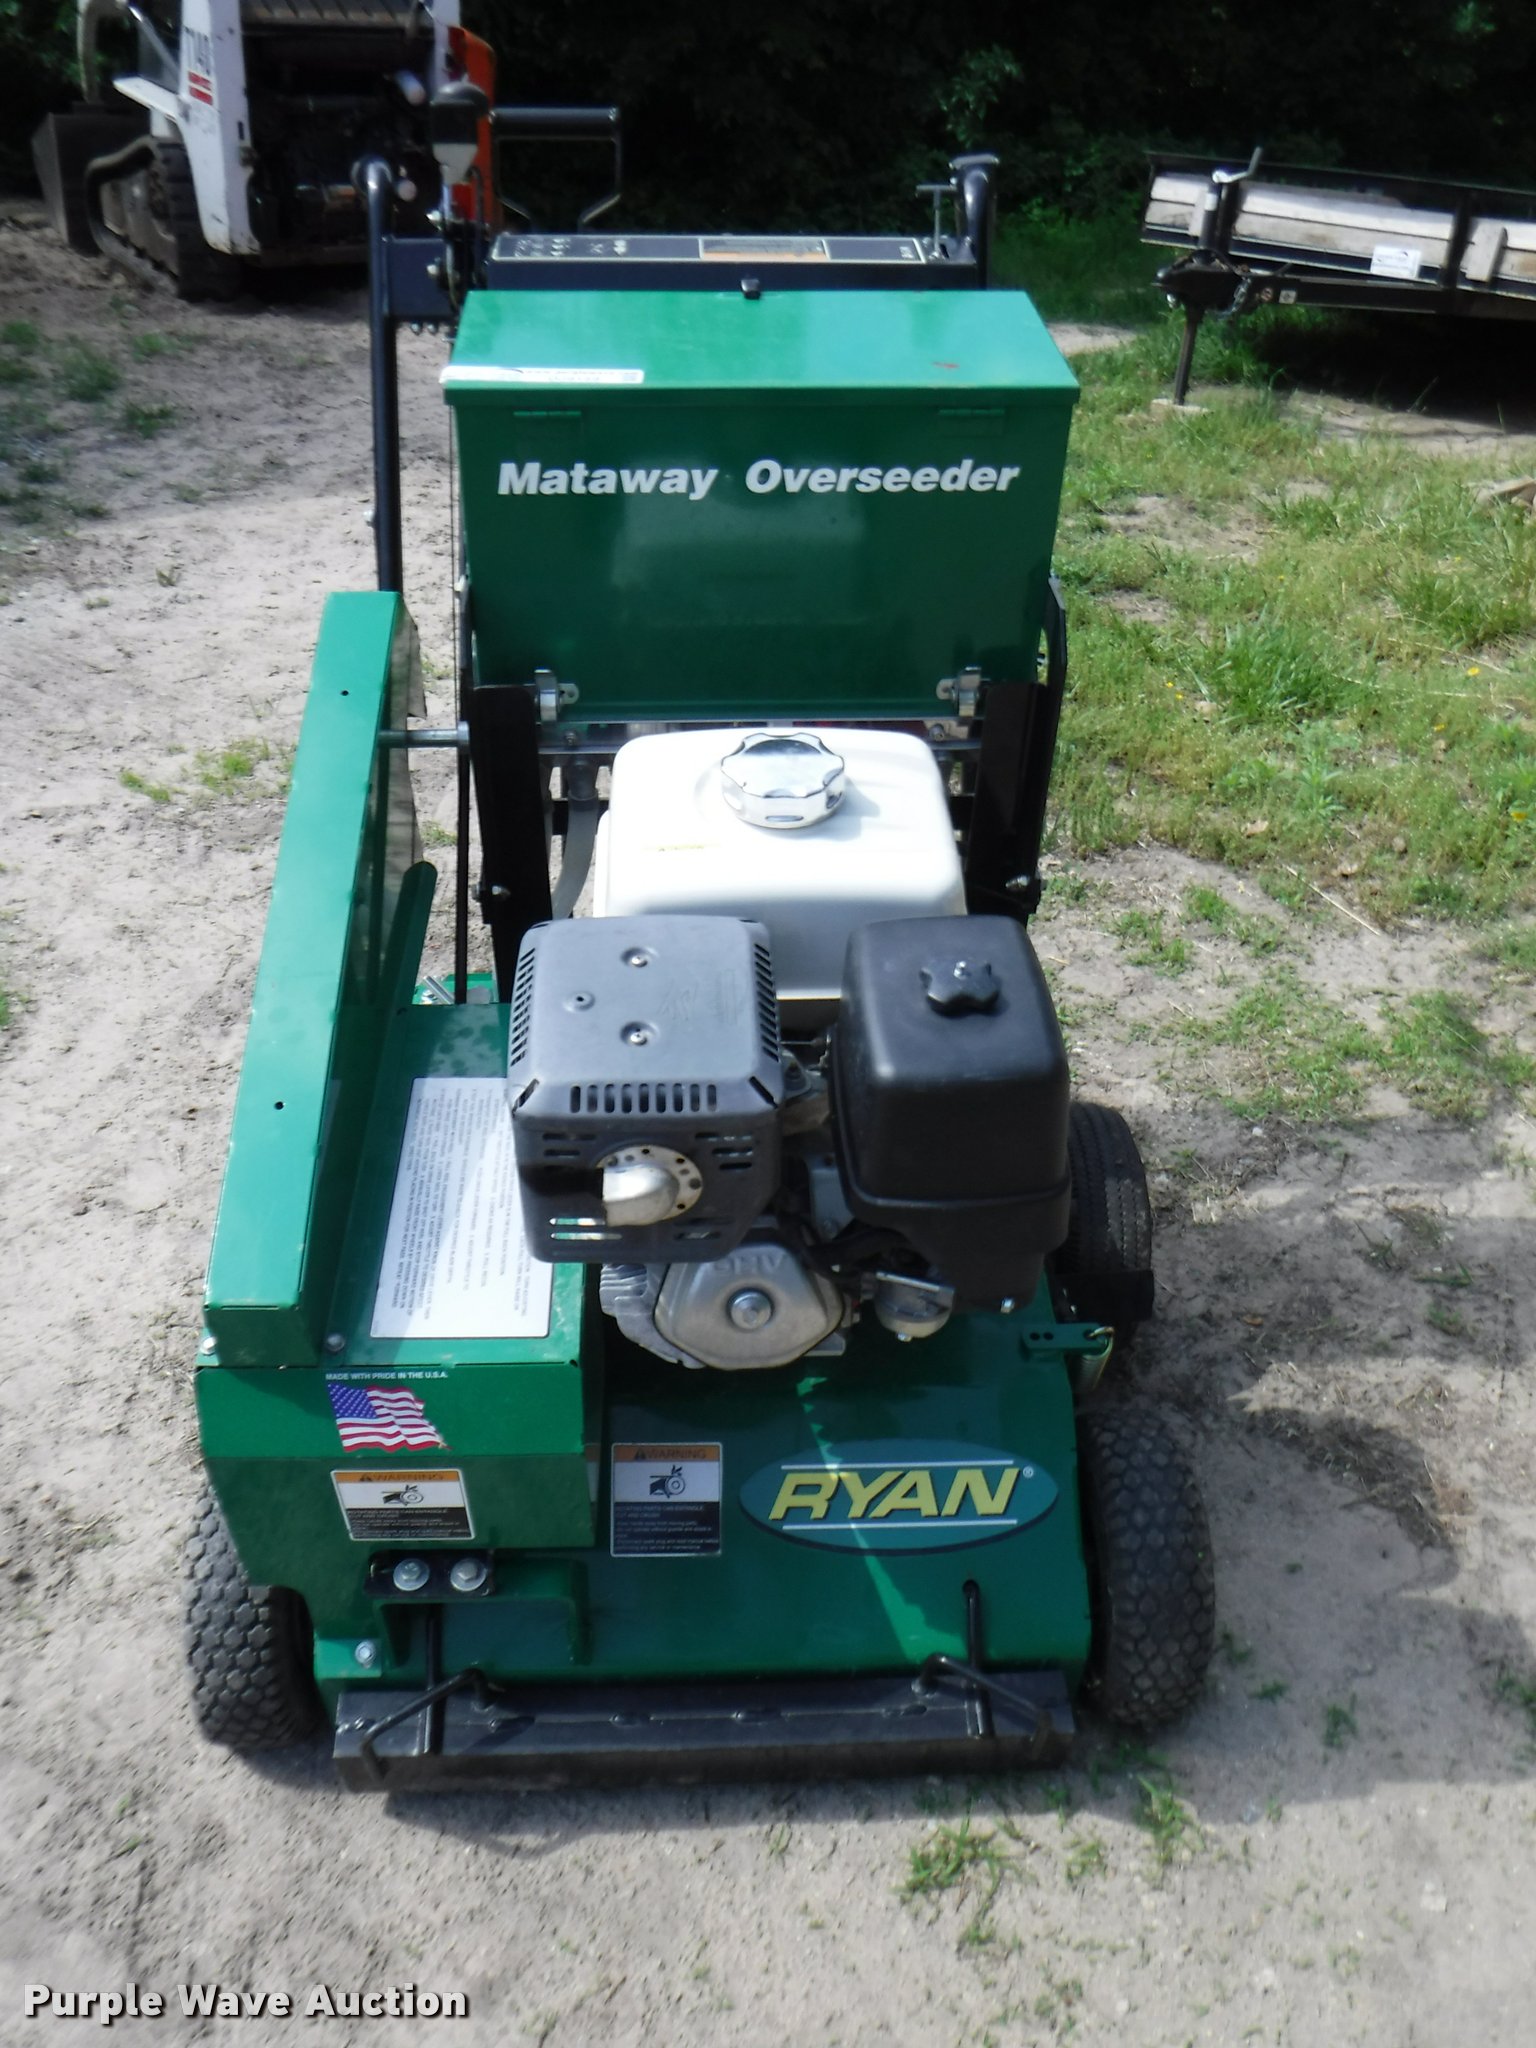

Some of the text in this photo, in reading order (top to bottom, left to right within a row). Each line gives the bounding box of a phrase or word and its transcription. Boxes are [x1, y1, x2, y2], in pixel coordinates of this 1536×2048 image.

[498, 459, 1021, 501] Mataway Overseeder
[351, 1372, 371, 1380] WITH
[372, 1372, 396, 1380] PRIDE
[397, 1371, 406, 1379] IN
[408, 1371, 424, 1379] THE
[425, 1370, 448, 1378] U.S.A.
[650, 1448, 707, 1459] WARNING
[768, 1468, 1021, 1520] RYAN
